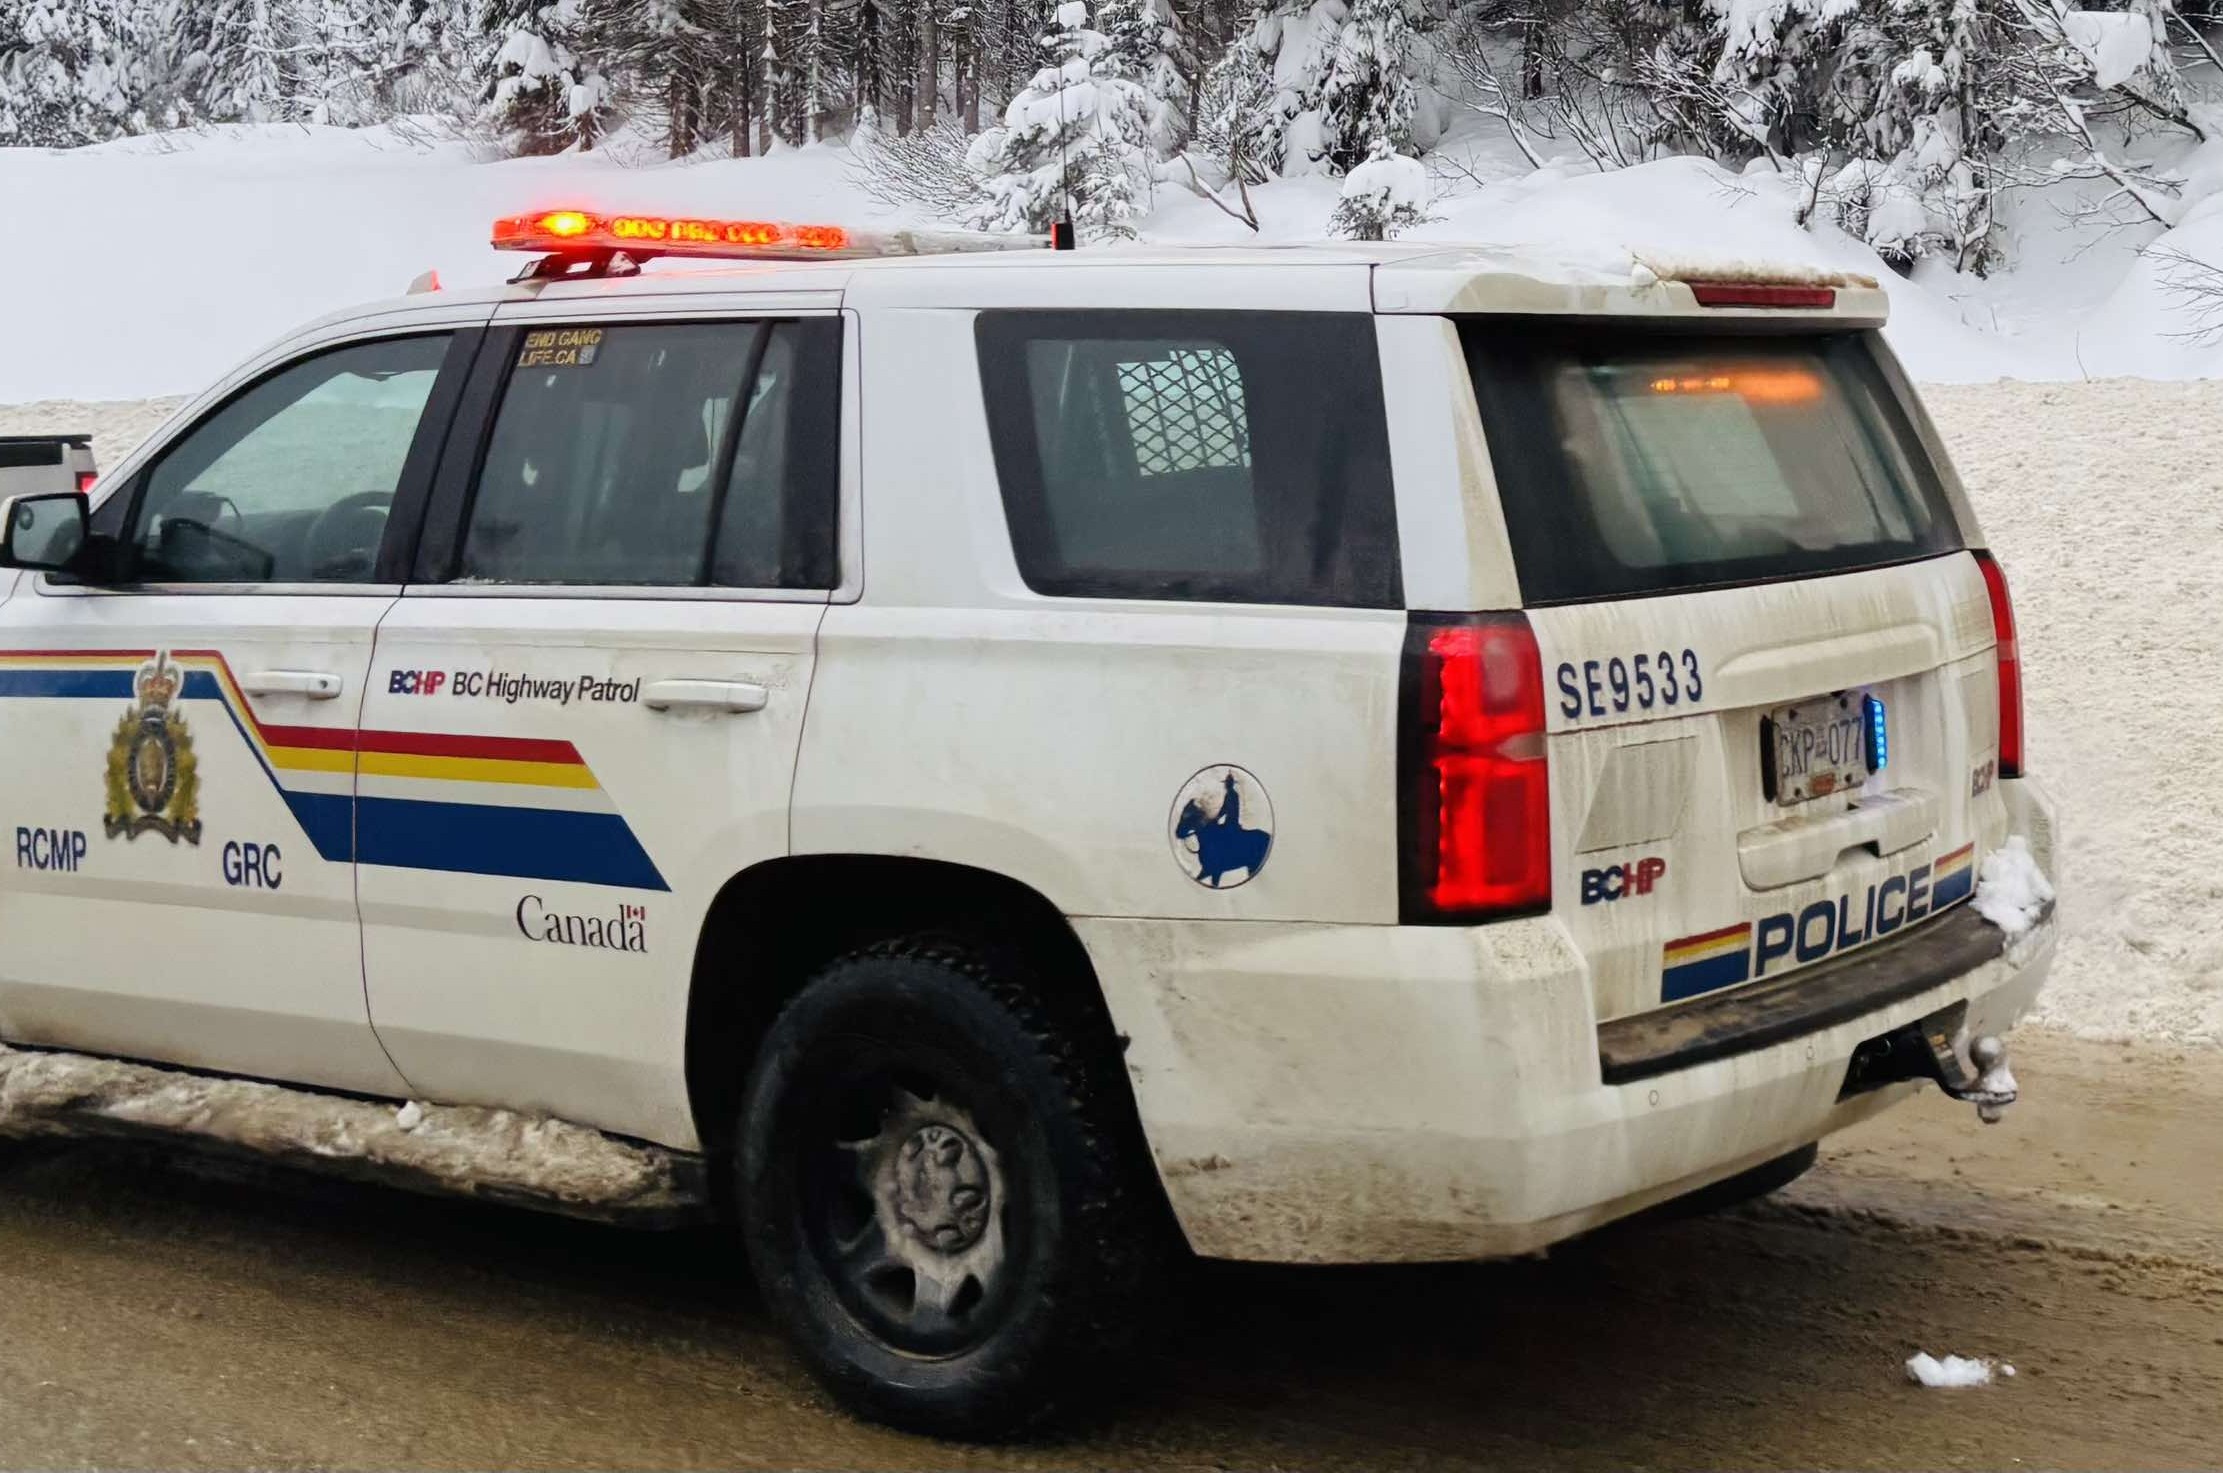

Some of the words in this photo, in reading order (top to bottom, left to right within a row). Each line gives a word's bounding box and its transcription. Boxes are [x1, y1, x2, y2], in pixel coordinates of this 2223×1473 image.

[526, 332, 556, 347] END
[558, 329, 602, 346] GANG
[388, 670, 446, 695] BCHP
[452, 671, 483, 697] BC
[486, 671, 575, 705] Highway
[577, 675, 641, 703] Patrol
[1557, 648, 1702, 719] SE9533
[16, 826, 87, 872] RCMP
[223, 840, 282, 889] GRC
[1581, 857, 1666, 906] BCHP
[516, 894, 648, 954] Canada
[1755, 864, 1931, 977] POLICE
